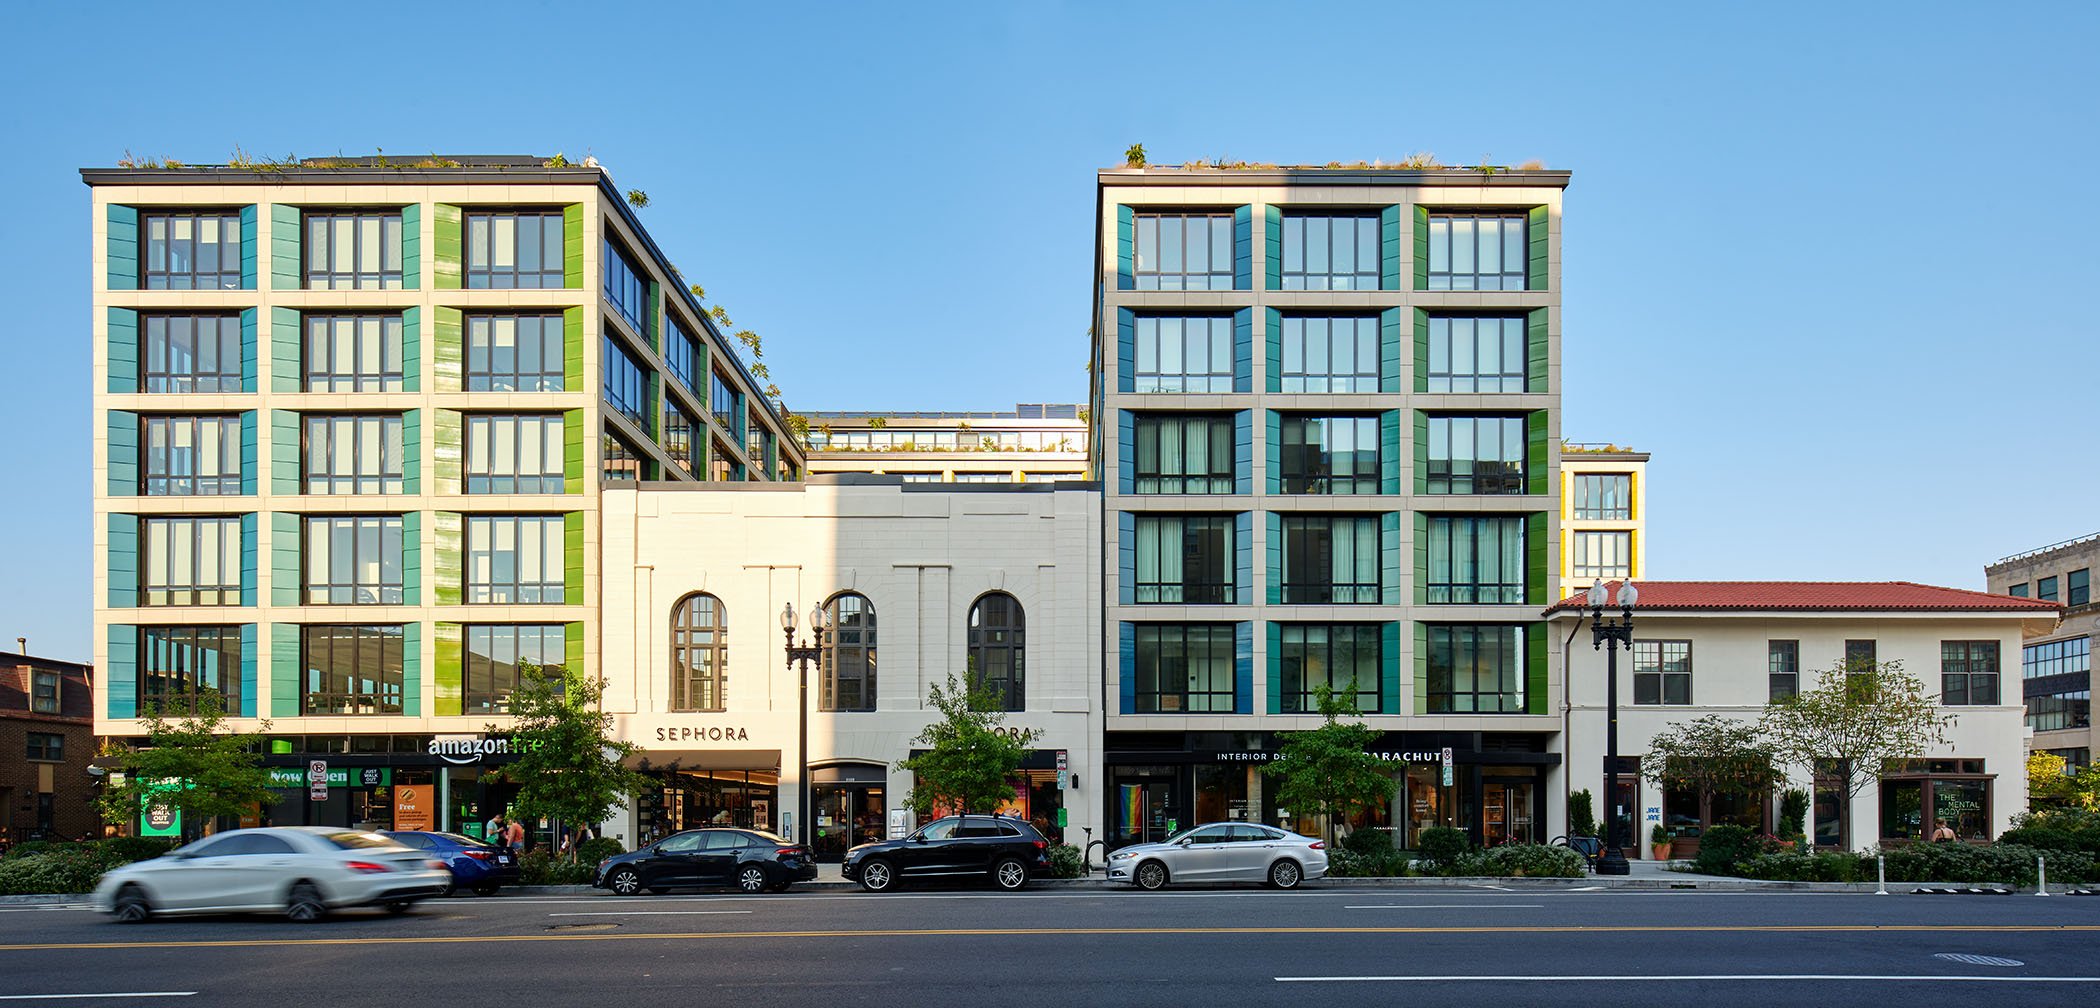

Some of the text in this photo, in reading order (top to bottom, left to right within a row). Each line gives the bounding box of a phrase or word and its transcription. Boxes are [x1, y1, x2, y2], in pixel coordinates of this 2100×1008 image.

[656, 727, 749, 741] SEPHORA
[428, 738, 508, 754] amazon
[1362, 752, 1441, 761] PARACHUT
[270, 771, 303, 782] Now
[1939, 793, 1956, 801] THE
[1948, 801, 1980, 809] MENTAL
[1938, 808, 1960, 816] BODY
